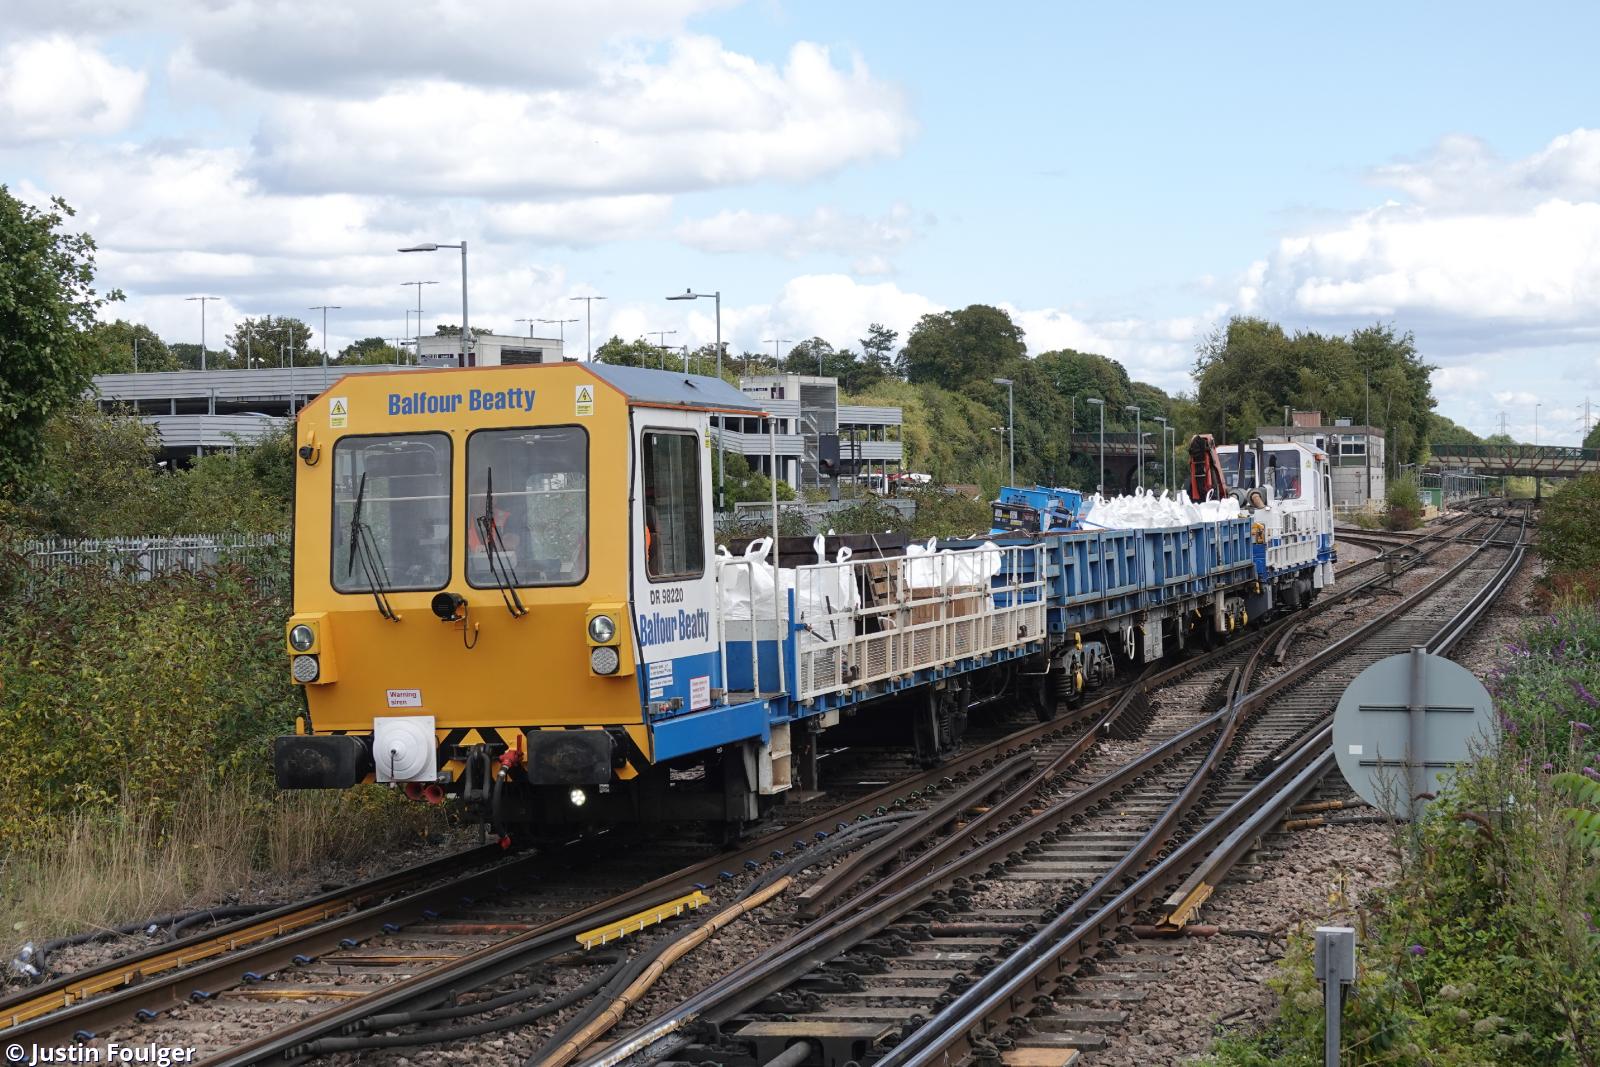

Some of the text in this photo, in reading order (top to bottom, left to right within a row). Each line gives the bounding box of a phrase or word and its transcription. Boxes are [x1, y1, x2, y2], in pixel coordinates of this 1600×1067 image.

[388, 387, 536, 416] Balfour Beatty
[650, 587, 684, 605] DR 98220
[640, 608, 710, 647] Balfour Beatty
[390, 691, 417, 699] Warning
